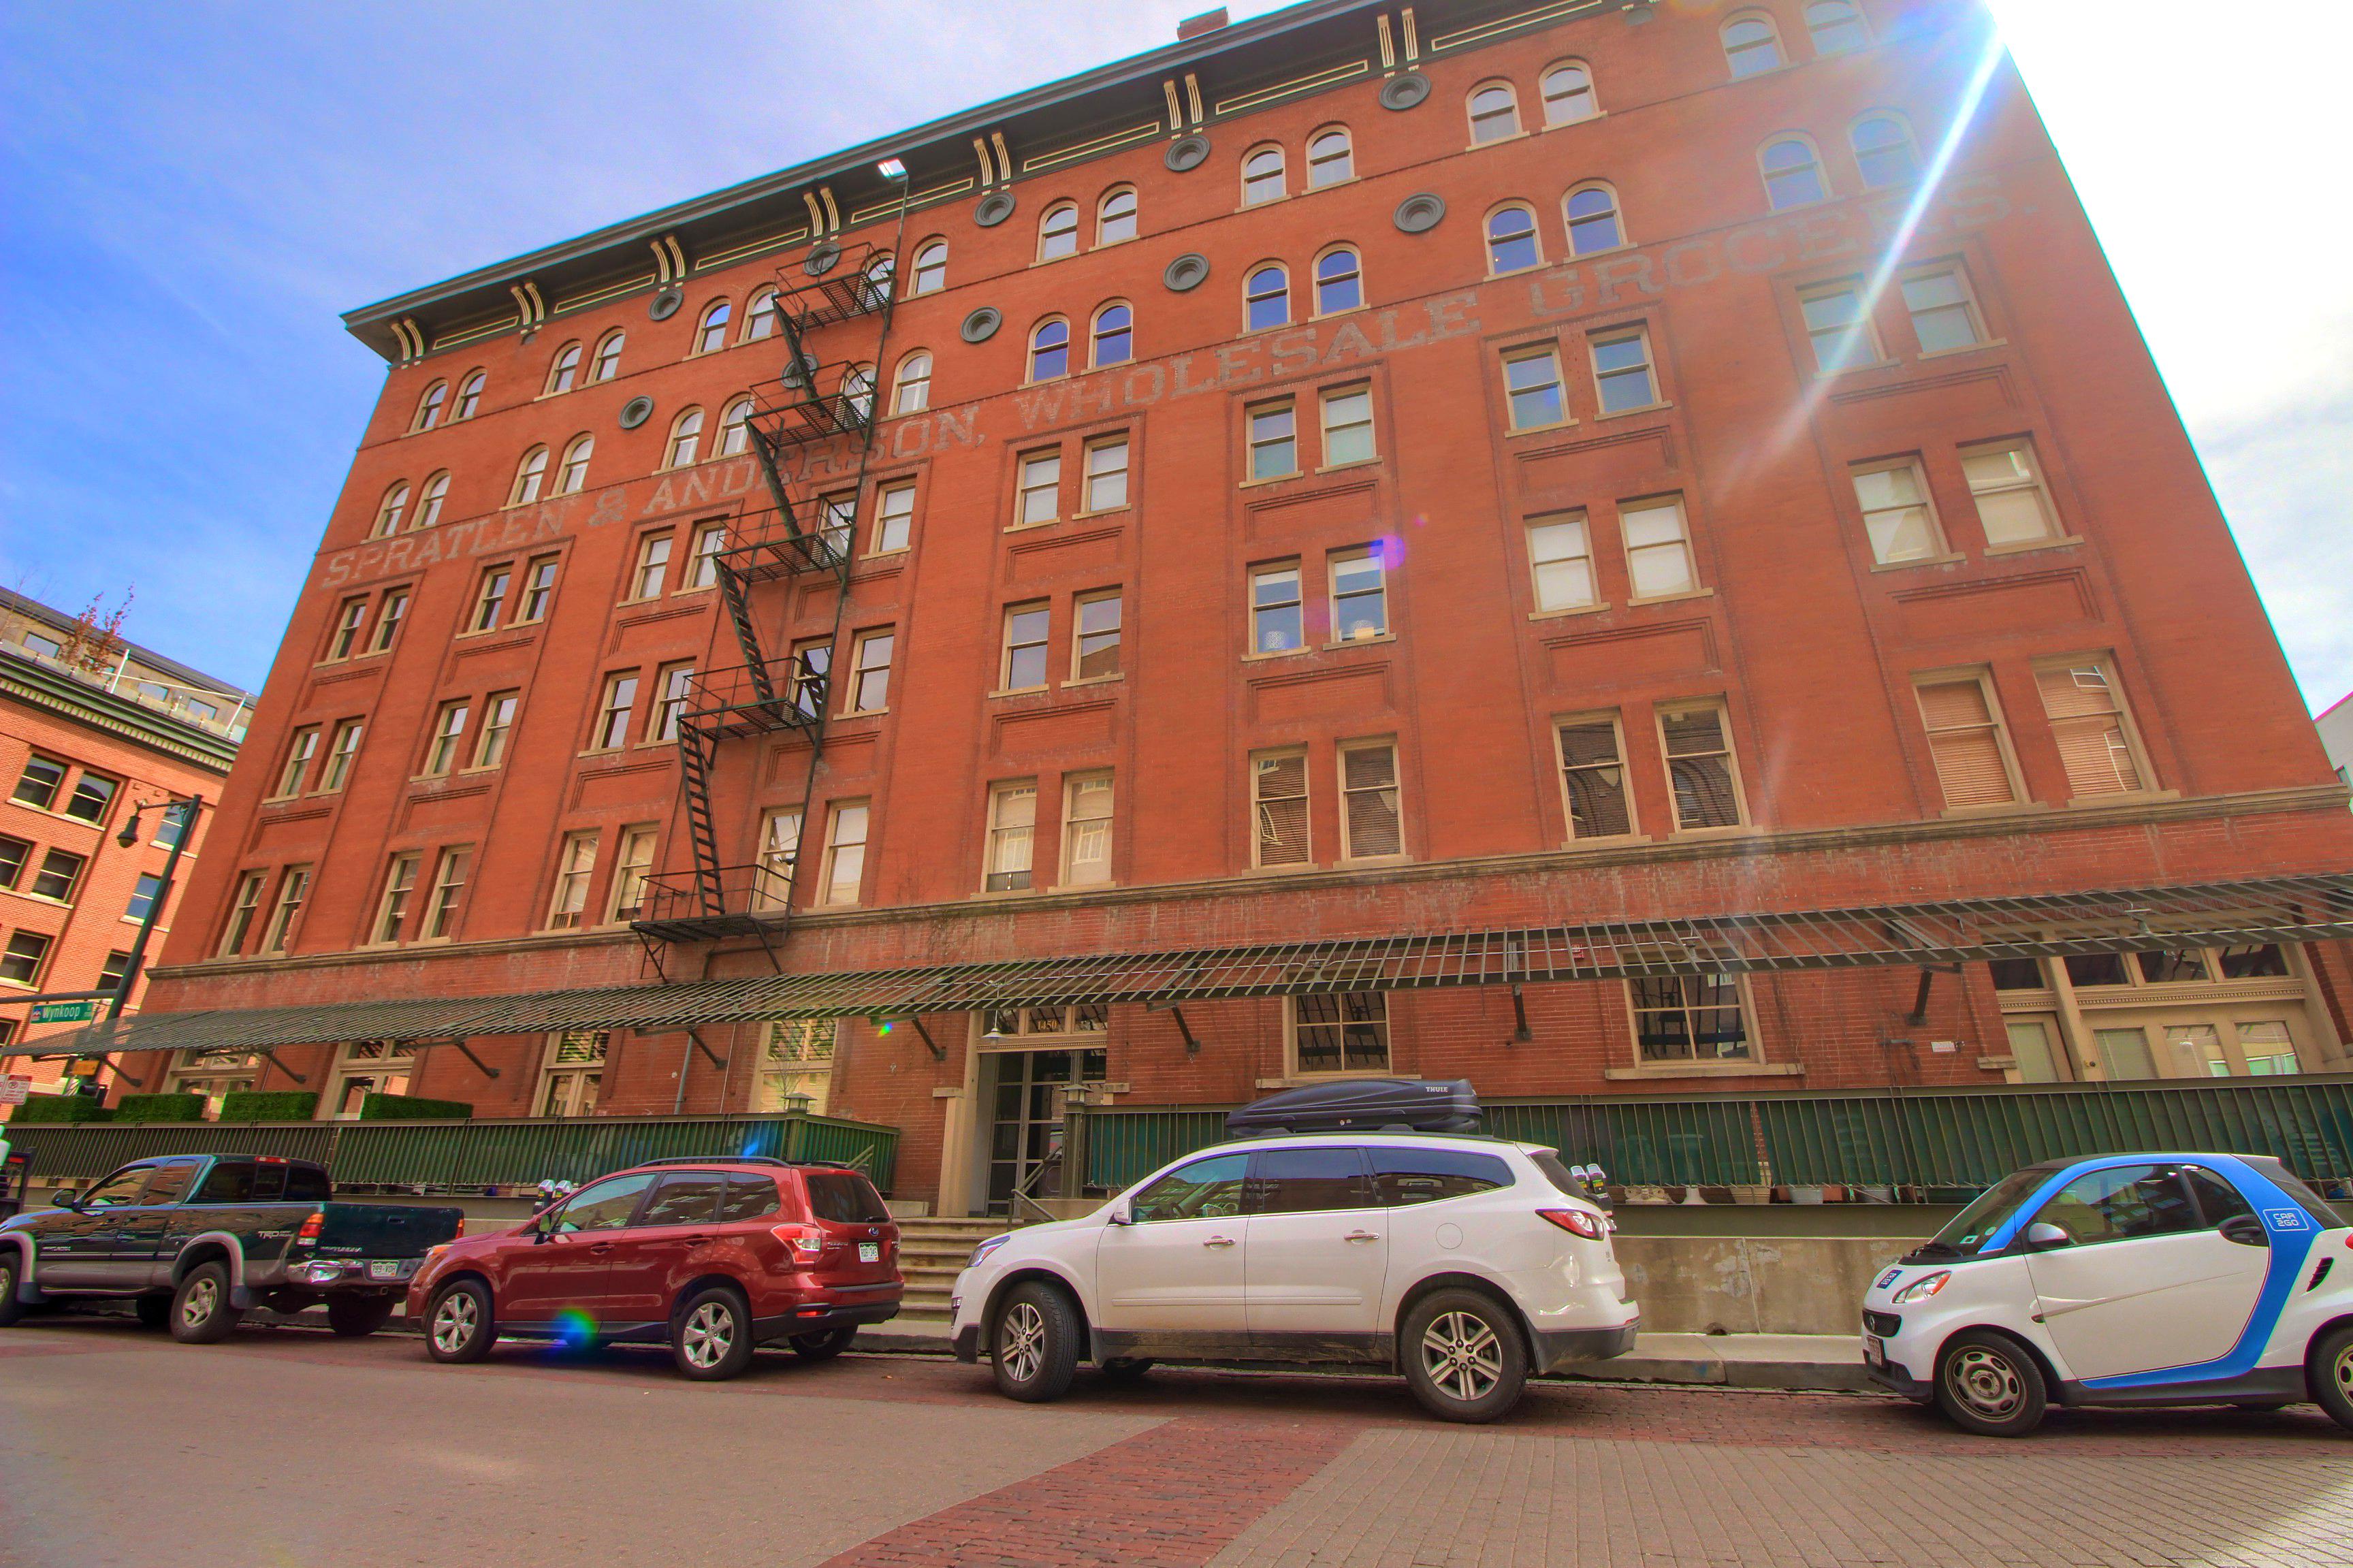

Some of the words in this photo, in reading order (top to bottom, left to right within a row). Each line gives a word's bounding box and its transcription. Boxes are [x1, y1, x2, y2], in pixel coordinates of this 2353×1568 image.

[319, 496, 581, 590] SPRATLEN
[588, 487, 627, 526] &
[1014, 291, 1481, 430] WHOLESALE
[42, 1005, 80, 1021] Wynkoop
[1038, 1019, 1057, 1029] 1450
